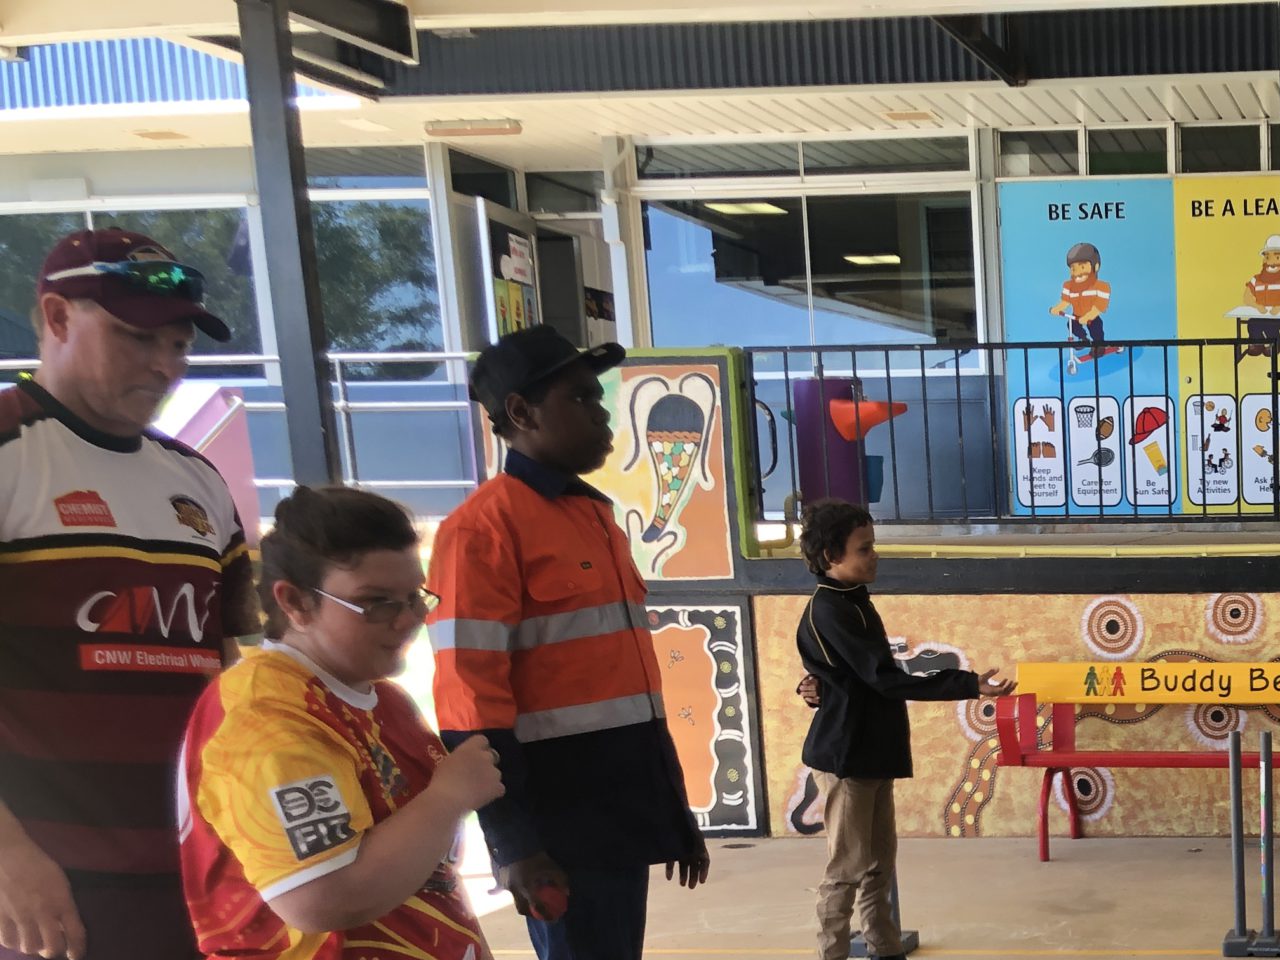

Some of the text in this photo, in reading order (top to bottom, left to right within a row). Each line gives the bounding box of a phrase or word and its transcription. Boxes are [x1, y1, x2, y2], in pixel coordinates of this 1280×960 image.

[1048, 202, 1126, 221] BE SAFE
[1191, 200, 1214, 217] BE
[1222, 200, 1235, 216] A
[1199, 478, 1210, 486] Ty
[1152, 487, 1169, 495] Safe
[95, 650, 132, 665] CNW
[1141, 667, 1232, 697] Buddy
[296, 818, 348, 854] FIT
